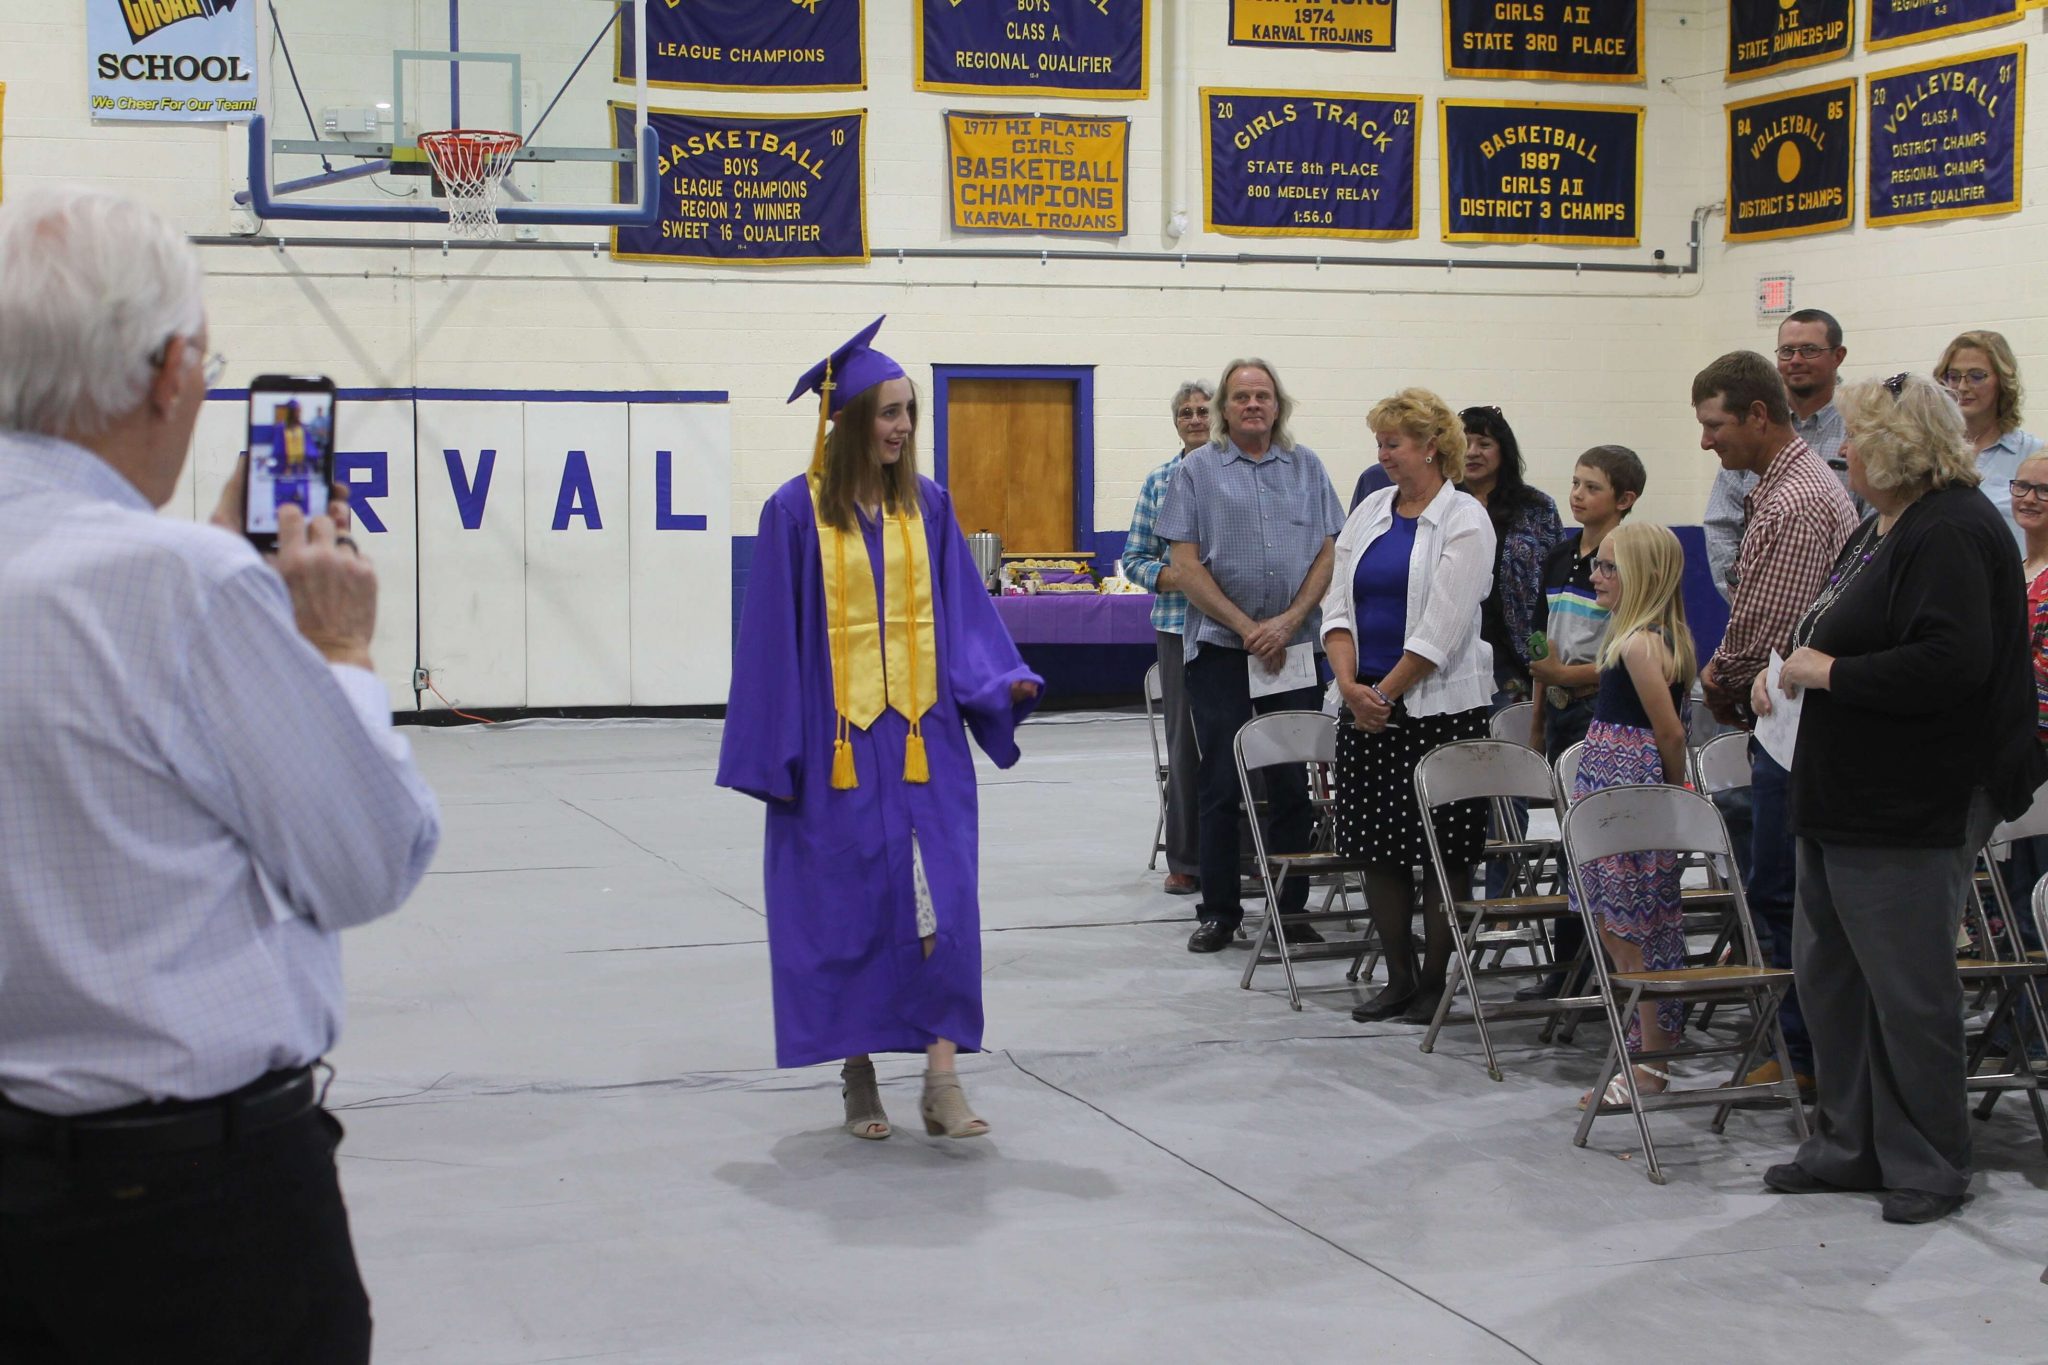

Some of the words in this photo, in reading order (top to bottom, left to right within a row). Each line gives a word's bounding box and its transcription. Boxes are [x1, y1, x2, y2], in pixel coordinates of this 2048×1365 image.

[1017, 0, 1050, 12] BOYS
[1495, 3, 1544, 22] GIRLS
[1295, 9, 1335, 24] 1974
[1007, 21, 1045, 40] CLASS
[1052, 24, 1060, 41] A
[1252, 24, 1305, 41] KARVAL
[1310, 27, 1373, 43] TROJANS
[1737, 38, 1769, 61] STATE
[1773, 20, 1844, 53] RUNNERS-UP
[658, 42, 721, 60] LEAGUE
[729, 48, 825, 63] CHAMPIONS
[1463, 32, 1514, 50] STATE
[1525, 33, 1557, 52] 3RD
[1572, 36, 1626, 55] PLACE
[98, 53, 250, 82] SCHOOL
[956, 51, 1030, 70] REGIONAL
[1038, 53, 1112, 73] QUALIFIER
[1999, 64, 2011, 84] 01
[92, 95, 114, 109] We
[117, 97, 158, 110] Cheer
[160, 98, 184, 111] For
[187, 98, 212, 111] Our
[215, 98, 257, 111] Team!
[1873, 88, 1886, 105] 20
[1883, 71, 1998, 135] VOLLEYBALL
[1217, 102, 1233, 119] 20
[1393, 108, 1410, 126] 02
[1827, 101, 1844, 120] 85
[1921, 109, 1948, 127] CLASS
[1951, 108, 1959, 123] A
[963, 120, 999, 135] 1977
[1006, 121, 1031, 136] HI
[1040, 121, 1112, 138] PLAINS
[1234, 103, 1297, 151] GIRLS
[1312, 101, 1393, 153] TRACK
[830, 129, 845, 146] 10
[1012, 139, 1075, 155] GIRLS
[1479, 125, 1599, 163] BASKETBALL
[1750, 115, 1825, 160] VOLLEYBALL
[1892, 138, 1938, 158] DISTRICT
[1943, 131, 1986, 151] CHAMPS
[658, 131, 824, 180] BASKETBALL
[1520, 152, 1560, 171] 1987
[724, 158, 759, 176] BOYS
[956, 156, 1118, 183] BASKETBALL
[1247, 160, 1294, 174] STATE
[1301, 162, 1324, 175] 8th
[1331, 163, 1379, 176] PLACE
[1891, 165, 1939, 184] REGIONAL
[1944, 158, 1985, 177] CHAMPS
[674, 177, 723, 197] LEAGUE
[734, 180, 807, 199] CHAMPIONS
[1247, 185, 1271, 199] 800
[1277, 186, 1329, 200] MEDLEY
[1336, 188, 1380, 201] RELAY
[1501, 176, 1551, 195] GIRLS
[961, 183, 1113, 210] CHAMPIONS
[1738, 196, 1784, 219] DISTRICT
[1786, 194, 1795, 213] 5
[1798, 187, 1842, 211] CHAMPS
[1891, 192, 1926, 209] STATE
[1930, 185, 1985, 204] QUALIFIER
[681, 200, 728, 218] REGION
[734, 202, 742, 219] 2
[753, 203, 801, 220] WINNER
[963, 210, 1032, 227] KARVAL
[1036, 212, 1117, 229] TROJANS
[1293, 211, 1333, 224] 1:56.0
[1460, 198, 1533, 218] DISTRICT
[1540, 201, 1551, 219] 3
[1560, 202, 1625, 221] CHAMPS
[662, 220, 709, 240] SWEET
[720, 223, 733, 240] 16
[743, 225, 820, 242] QUALIFIER
[334, 449, 707, 533] RVAL
